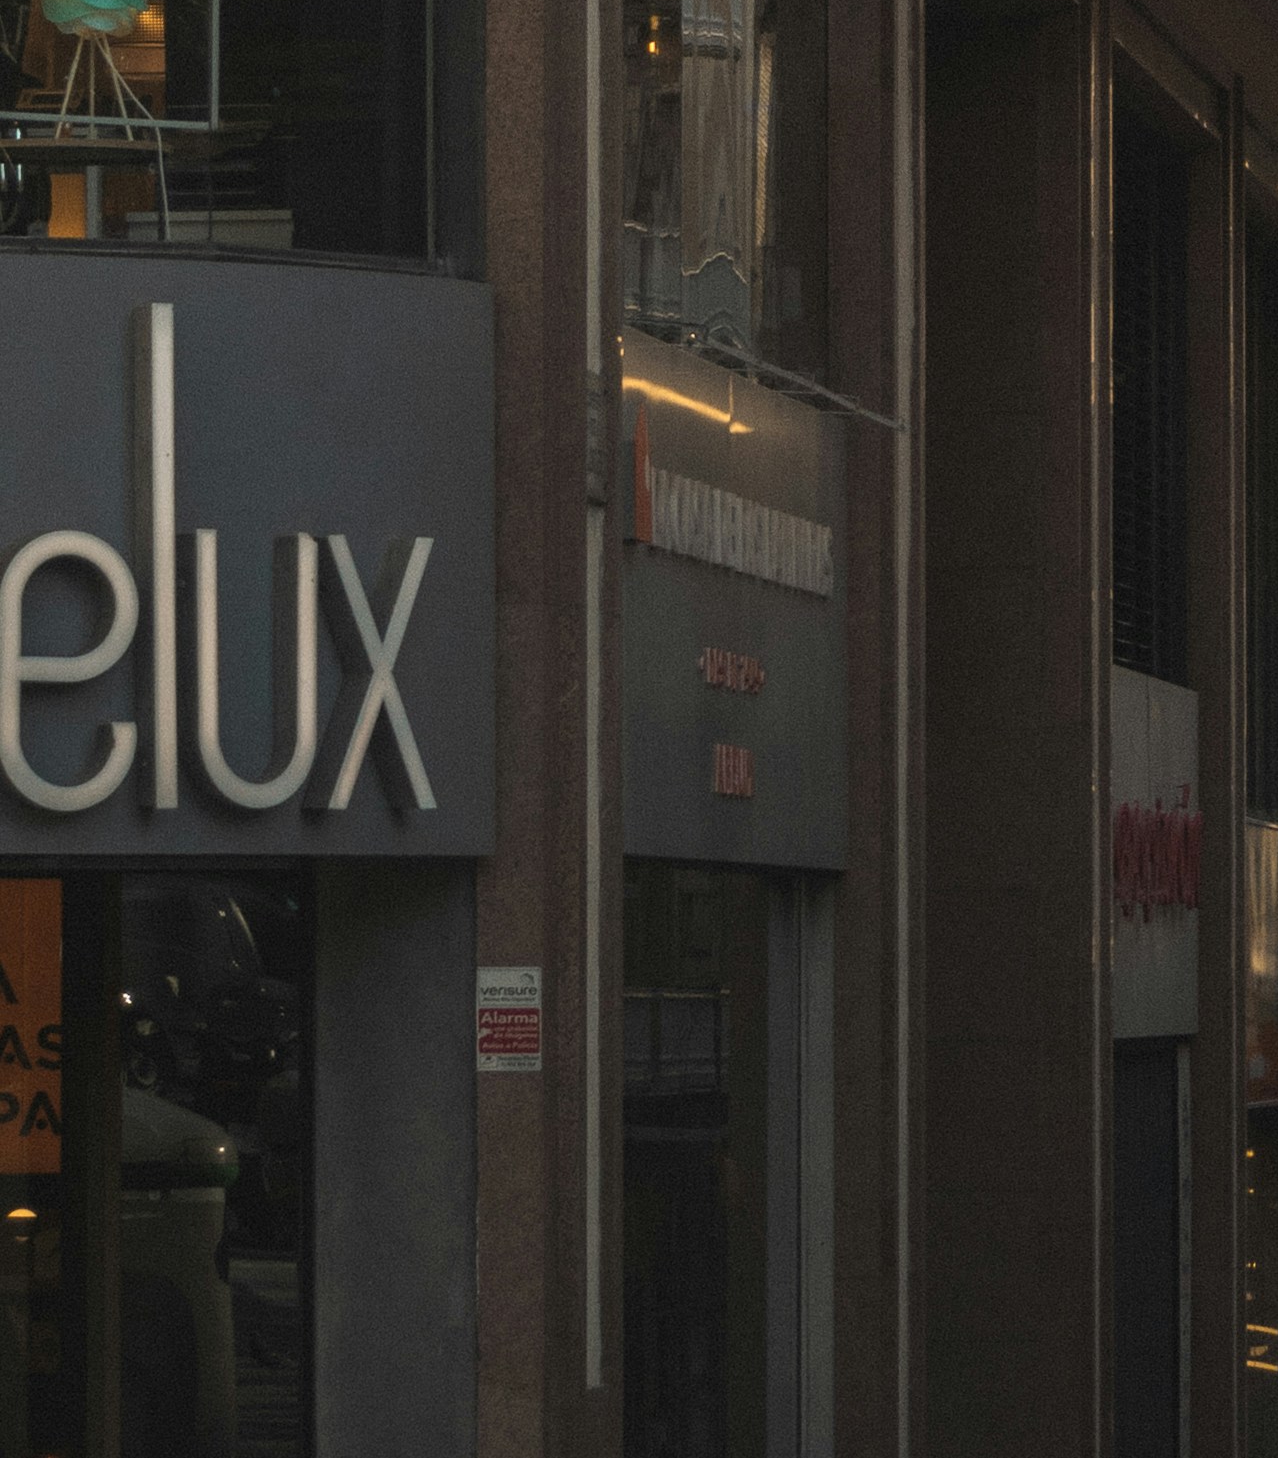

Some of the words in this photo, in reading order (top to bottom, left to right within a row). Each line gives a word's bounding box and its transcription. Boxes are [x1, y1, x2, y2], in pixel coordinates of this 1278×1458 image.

[0, 302, 437, 812] elux
[480, 986, 538, 997] verisure
[481, 1011, 538, 1024] Alarma
